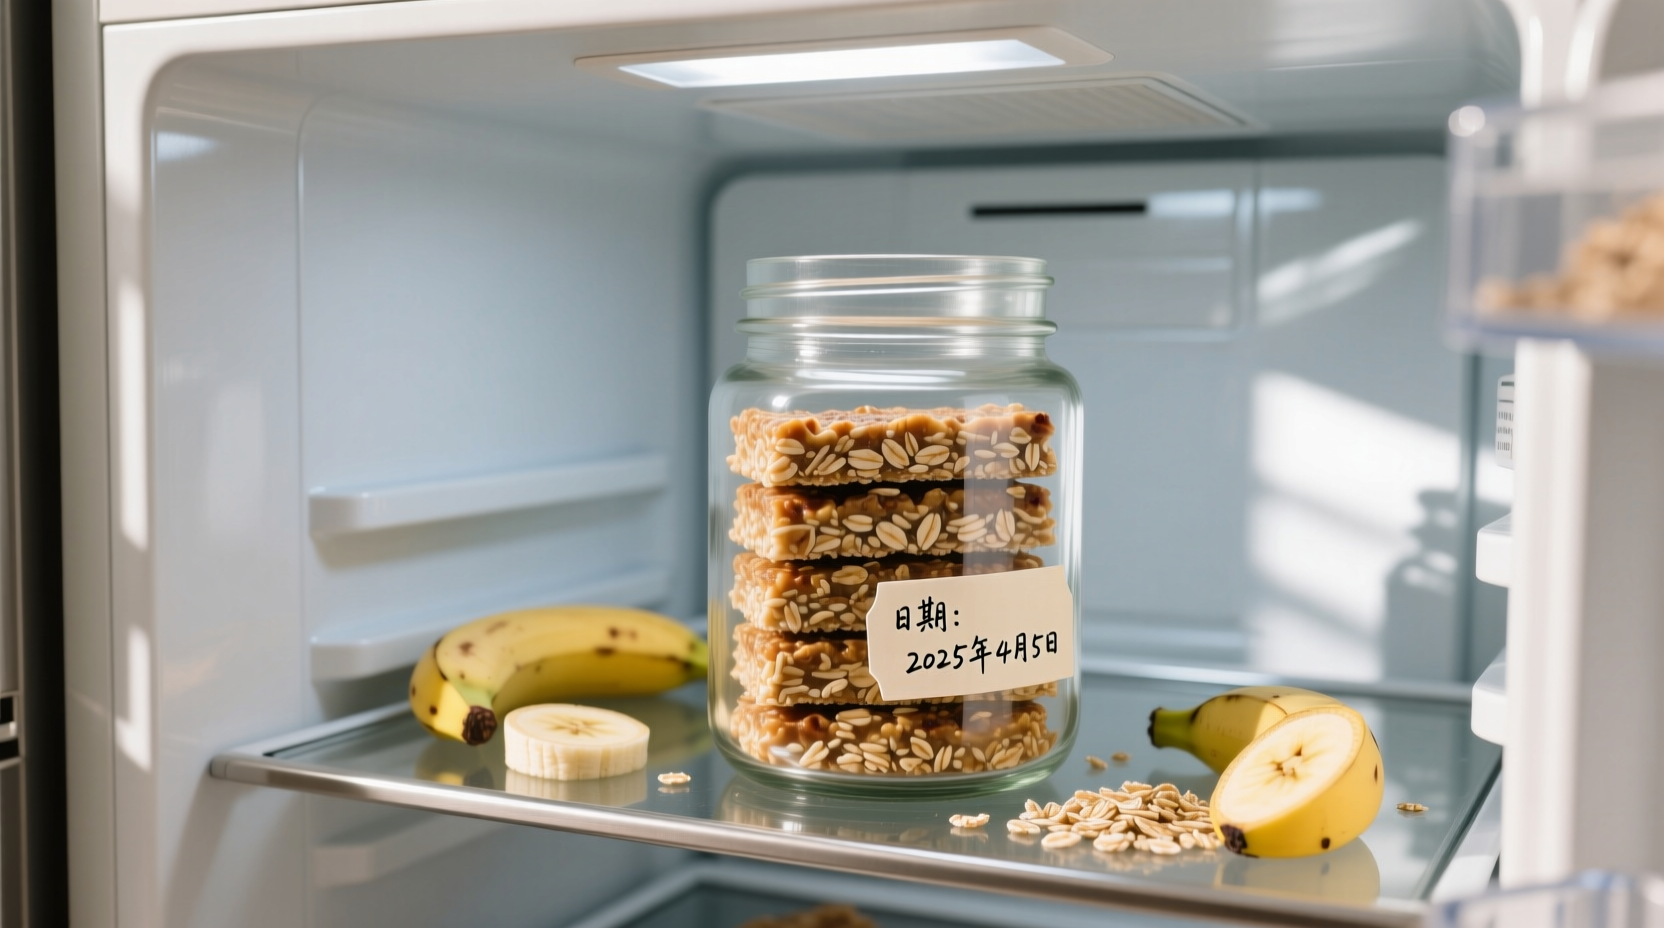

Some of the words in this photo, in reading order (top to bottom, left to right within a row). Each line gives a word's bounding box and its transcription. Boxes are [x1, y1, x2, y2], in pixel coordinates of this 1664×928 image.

[896, 596, 959, 632] 日期：
[906, 631, 1058, 674] 2025年4月5日
